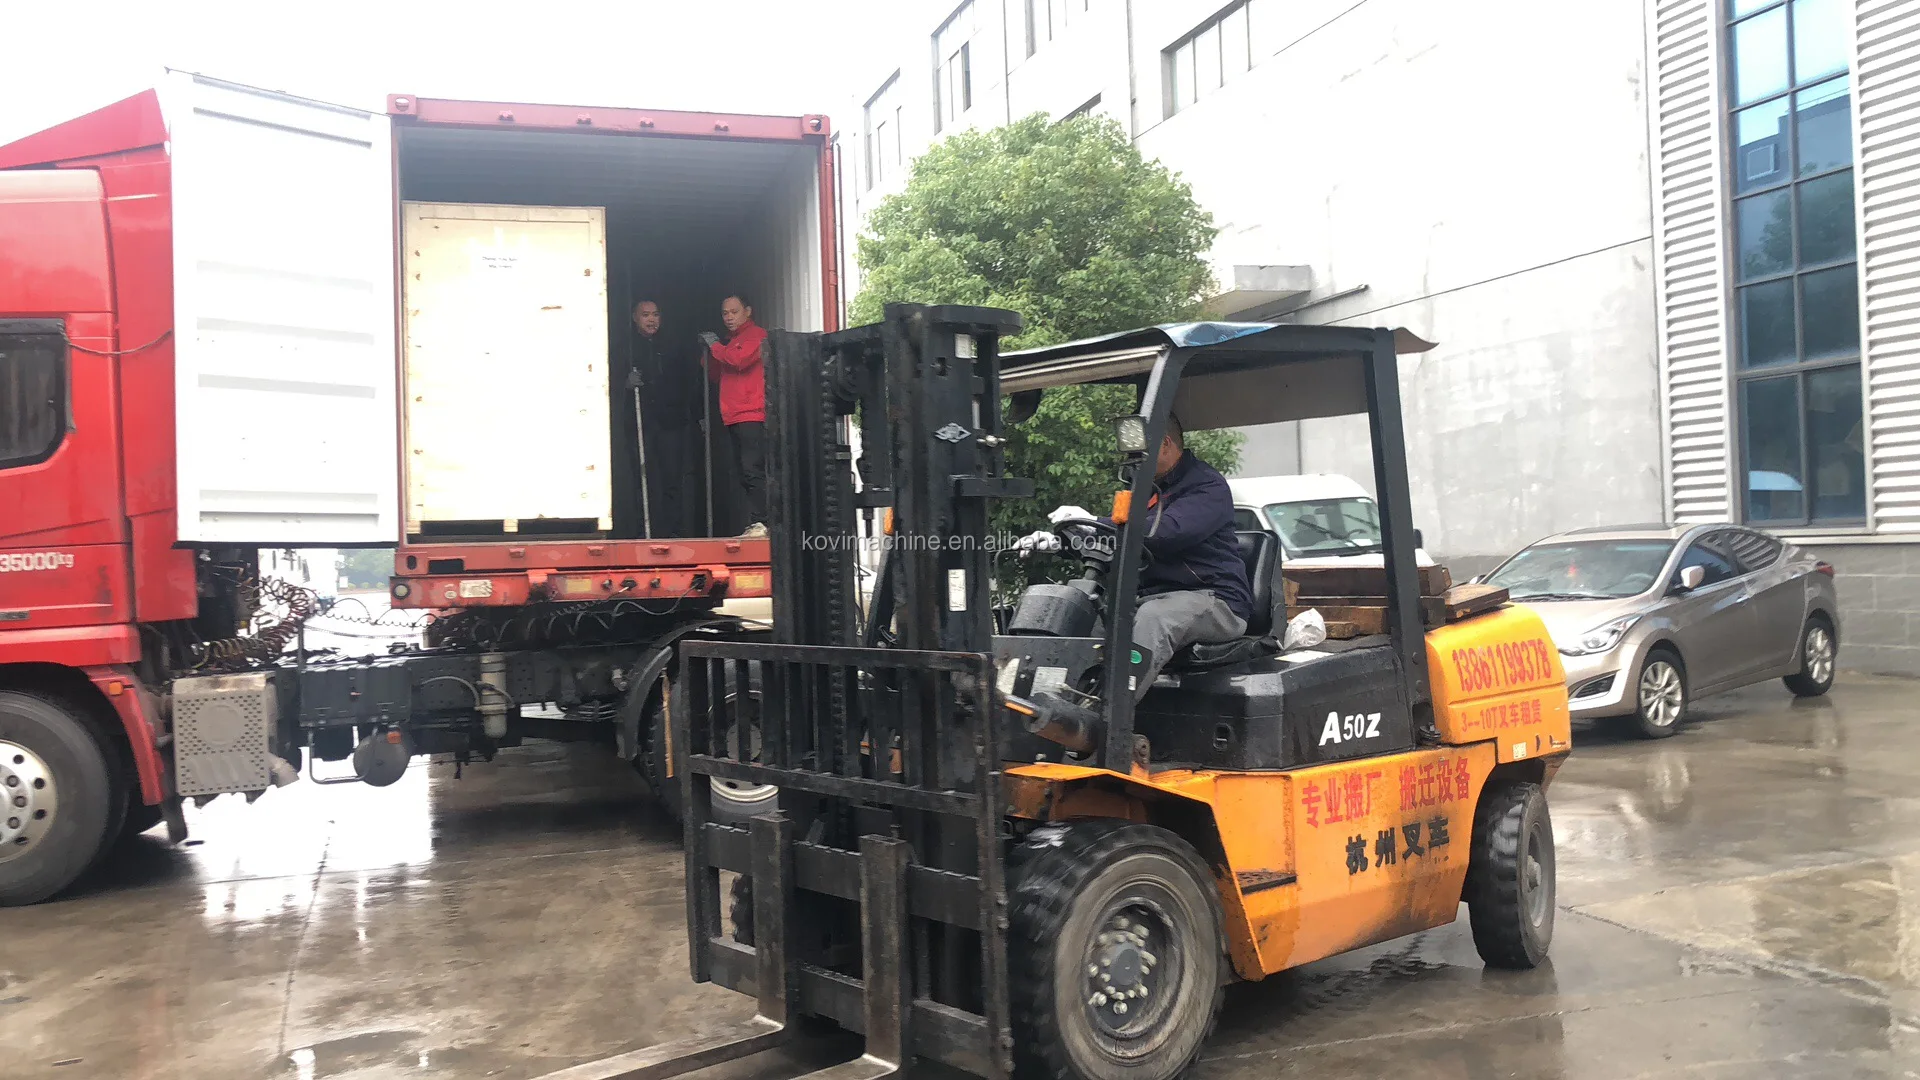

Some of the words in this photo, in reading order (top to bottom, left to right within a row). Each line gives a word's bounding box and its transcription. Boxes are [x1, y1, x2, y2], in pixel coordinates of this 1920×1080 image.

[1452, 638, 1551, 693] 13861199378
[1302, 772, 1381, 828] 专业搬厂
[1399, 756, 1470, 811] 搬迁设备
[1346, 816, 1449, 875] 杭州叉车
